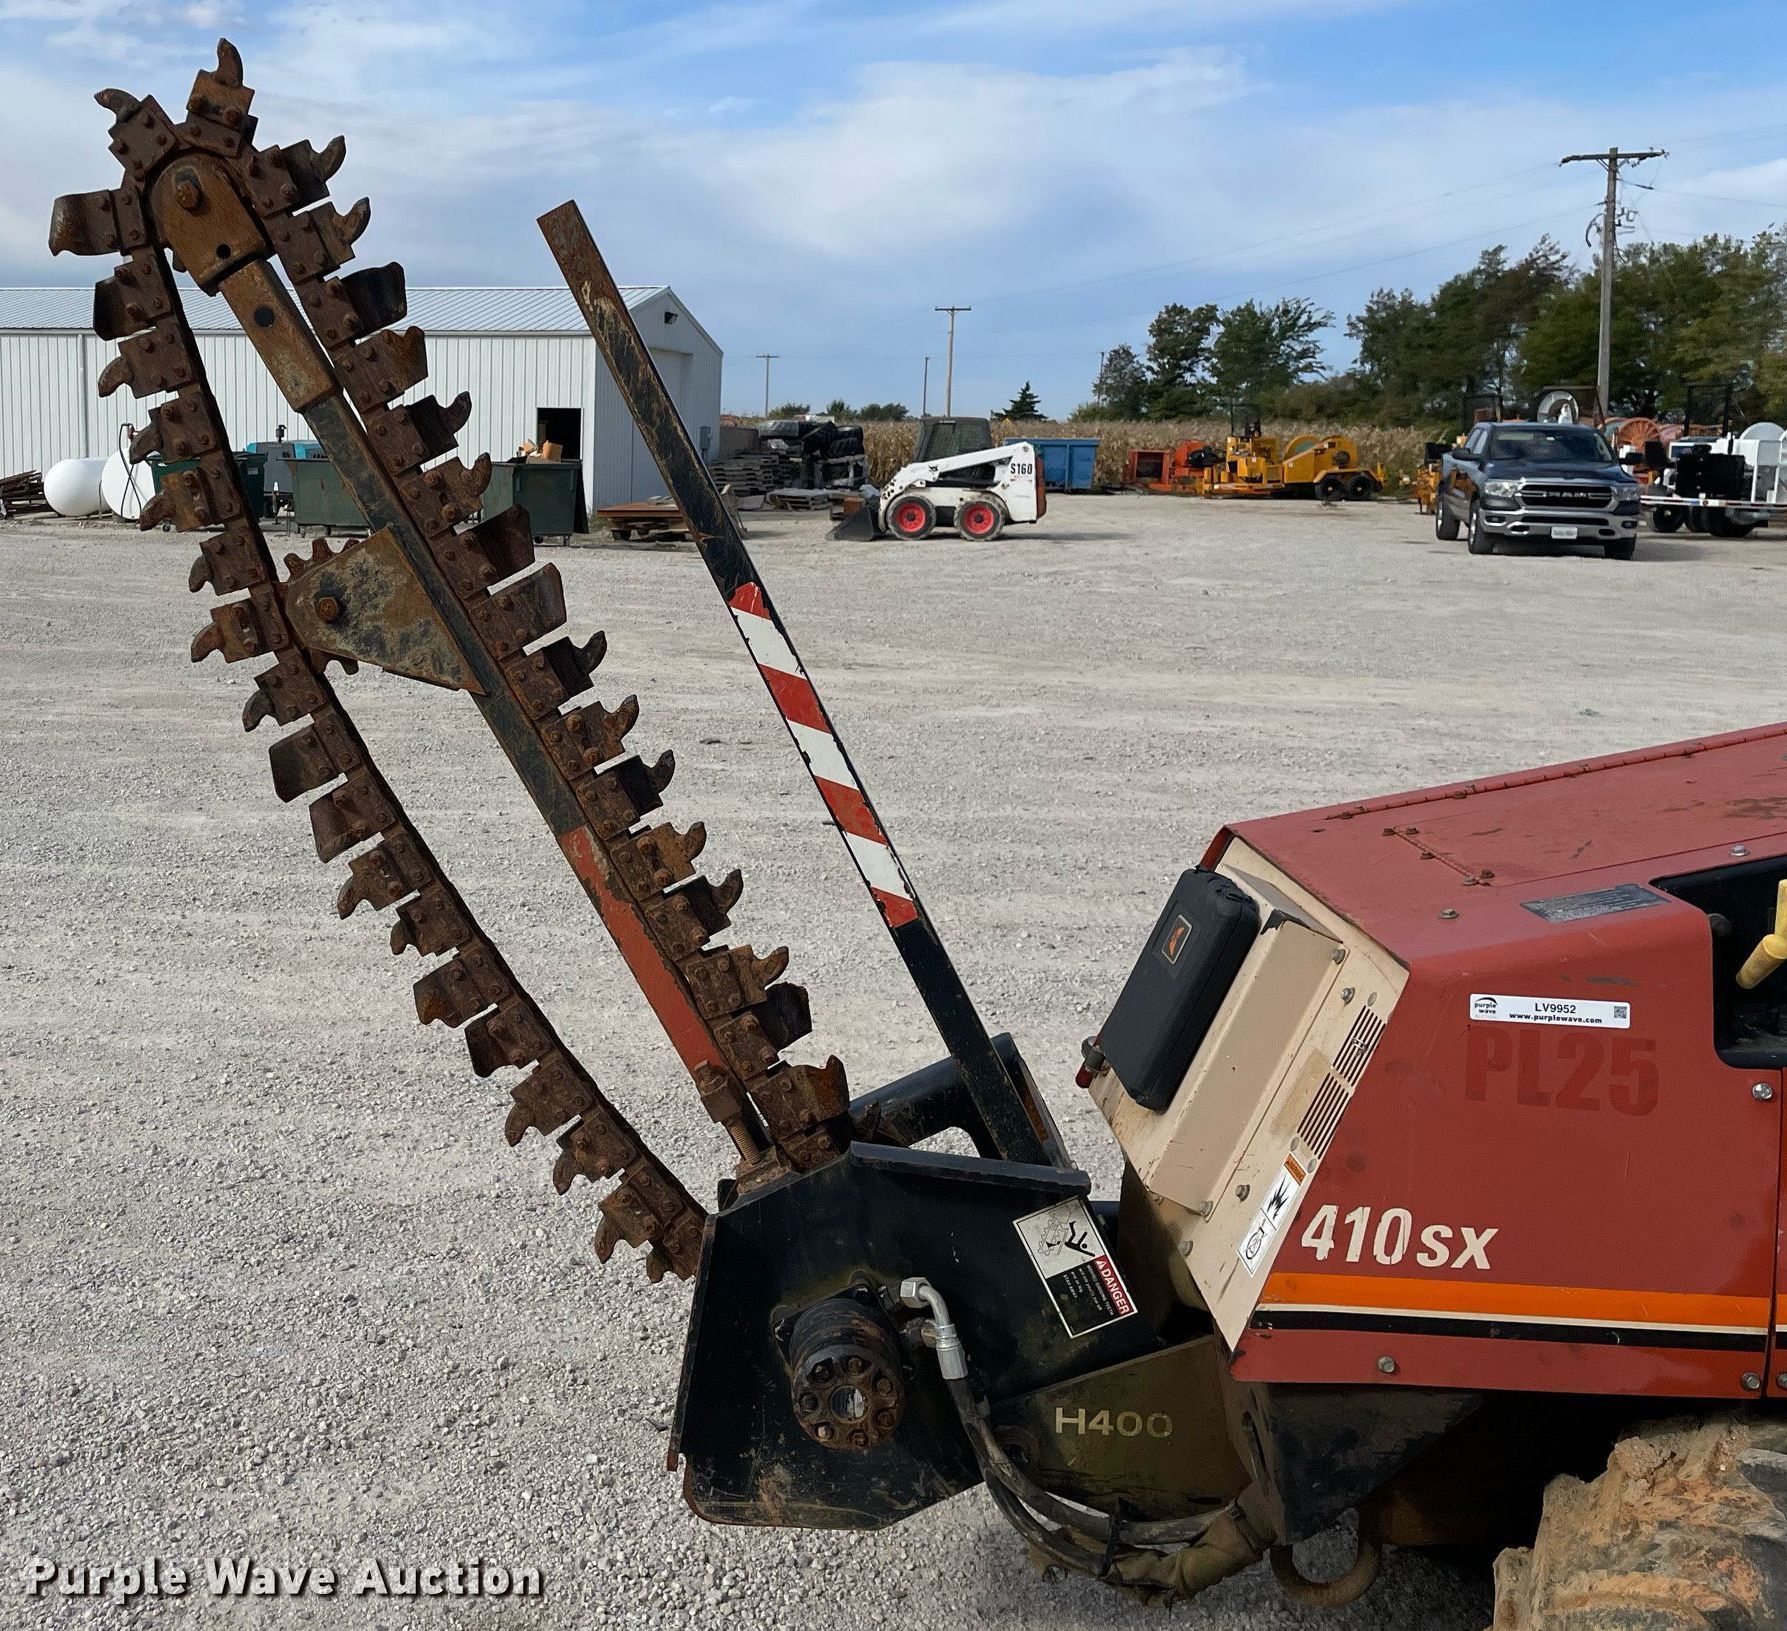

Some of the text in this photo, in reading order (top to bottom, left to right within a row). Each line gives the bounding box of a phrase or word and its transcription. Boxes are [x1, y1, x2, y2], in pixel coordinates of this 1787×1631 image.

[1010, 463, 1033, 475] S160
[1474, 1002, 1497, 1010] purple
[1534, 1003, 1577, 1014] LV9952
[1509, 1012, 1603, 1024] www.purplewave.com
[1465, 1026, 1659, 1117] PL25
[1101, 1268, 1130, 1315] DANGER
[1055, 1407, 1174, 1438] H400
